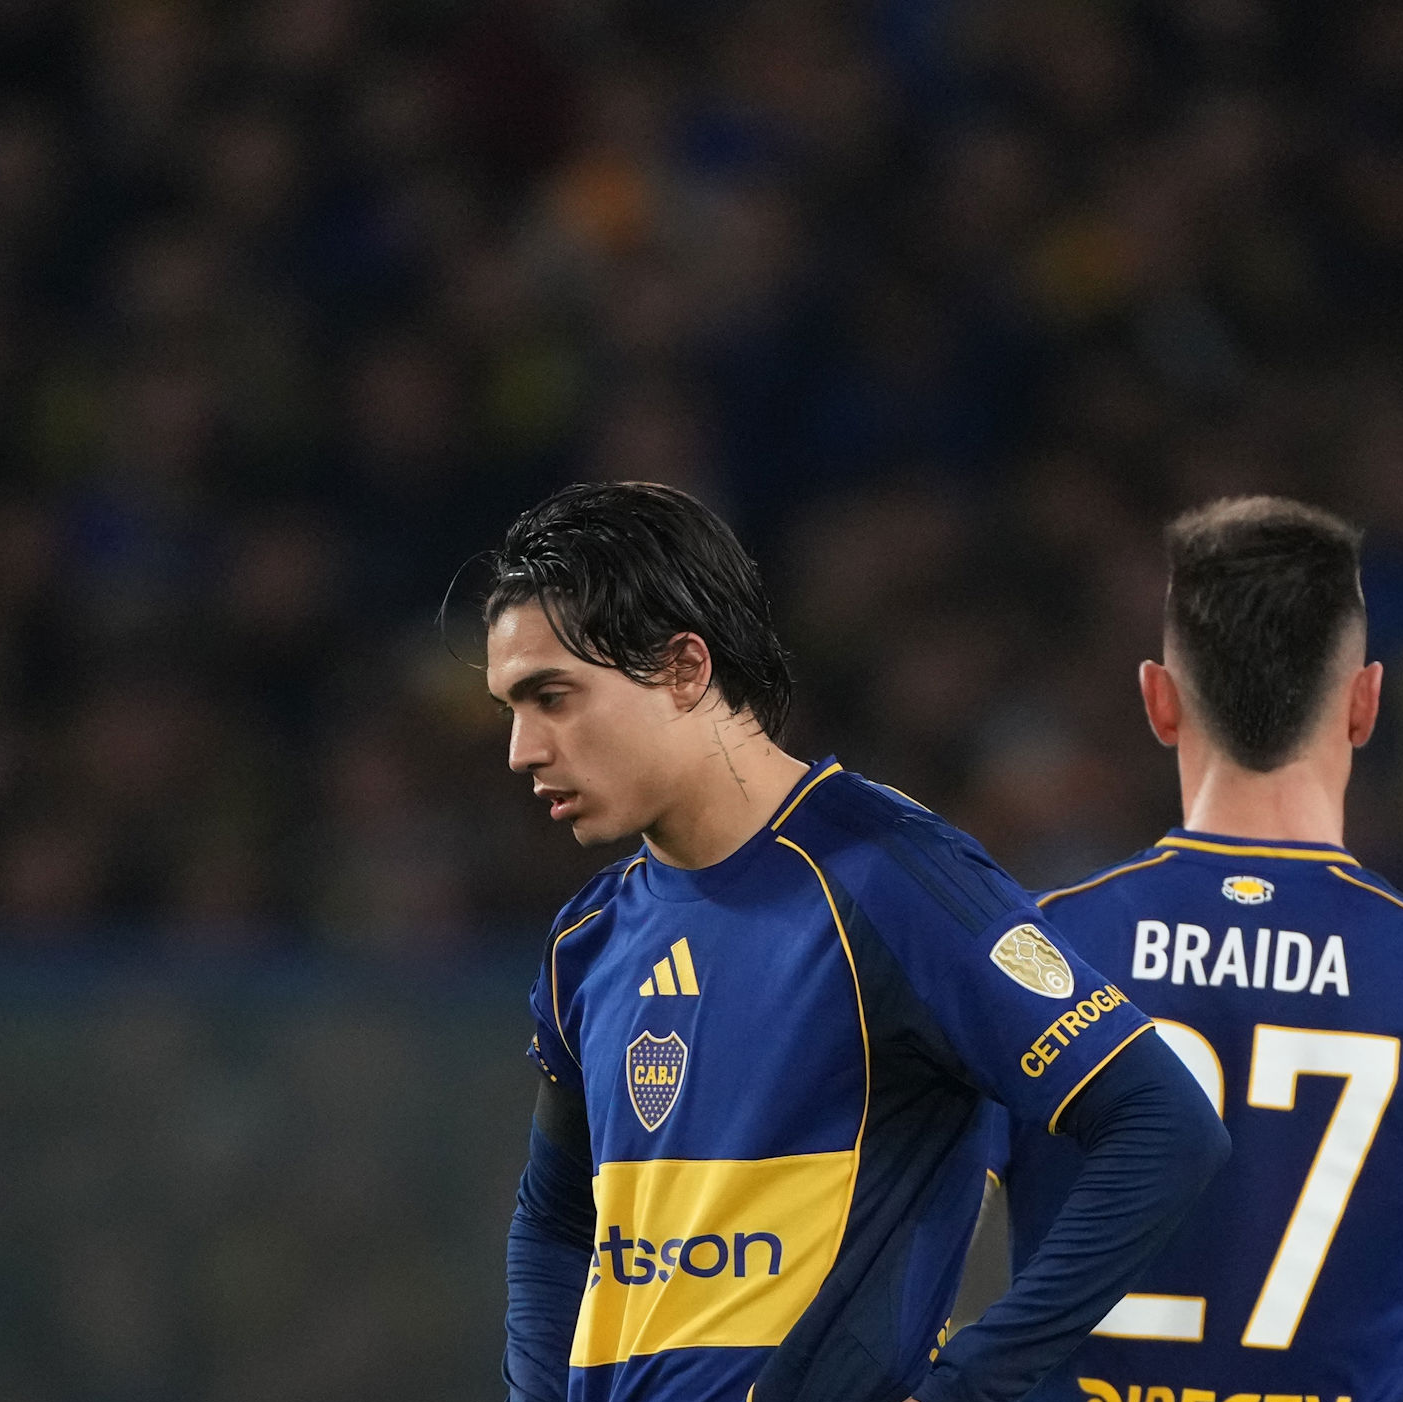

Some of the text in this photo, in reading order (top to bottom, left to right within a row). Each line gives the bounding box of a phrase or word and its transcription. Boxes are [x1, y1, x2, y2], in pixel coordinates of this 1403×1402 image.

[1132, 919, 1350, 997] BRAIDA
[1020, 983, 1130, 1078] CETROGA
[634, 1065, 678, 1086] CABJ
[589, 1225, 783, 1292] tsson
